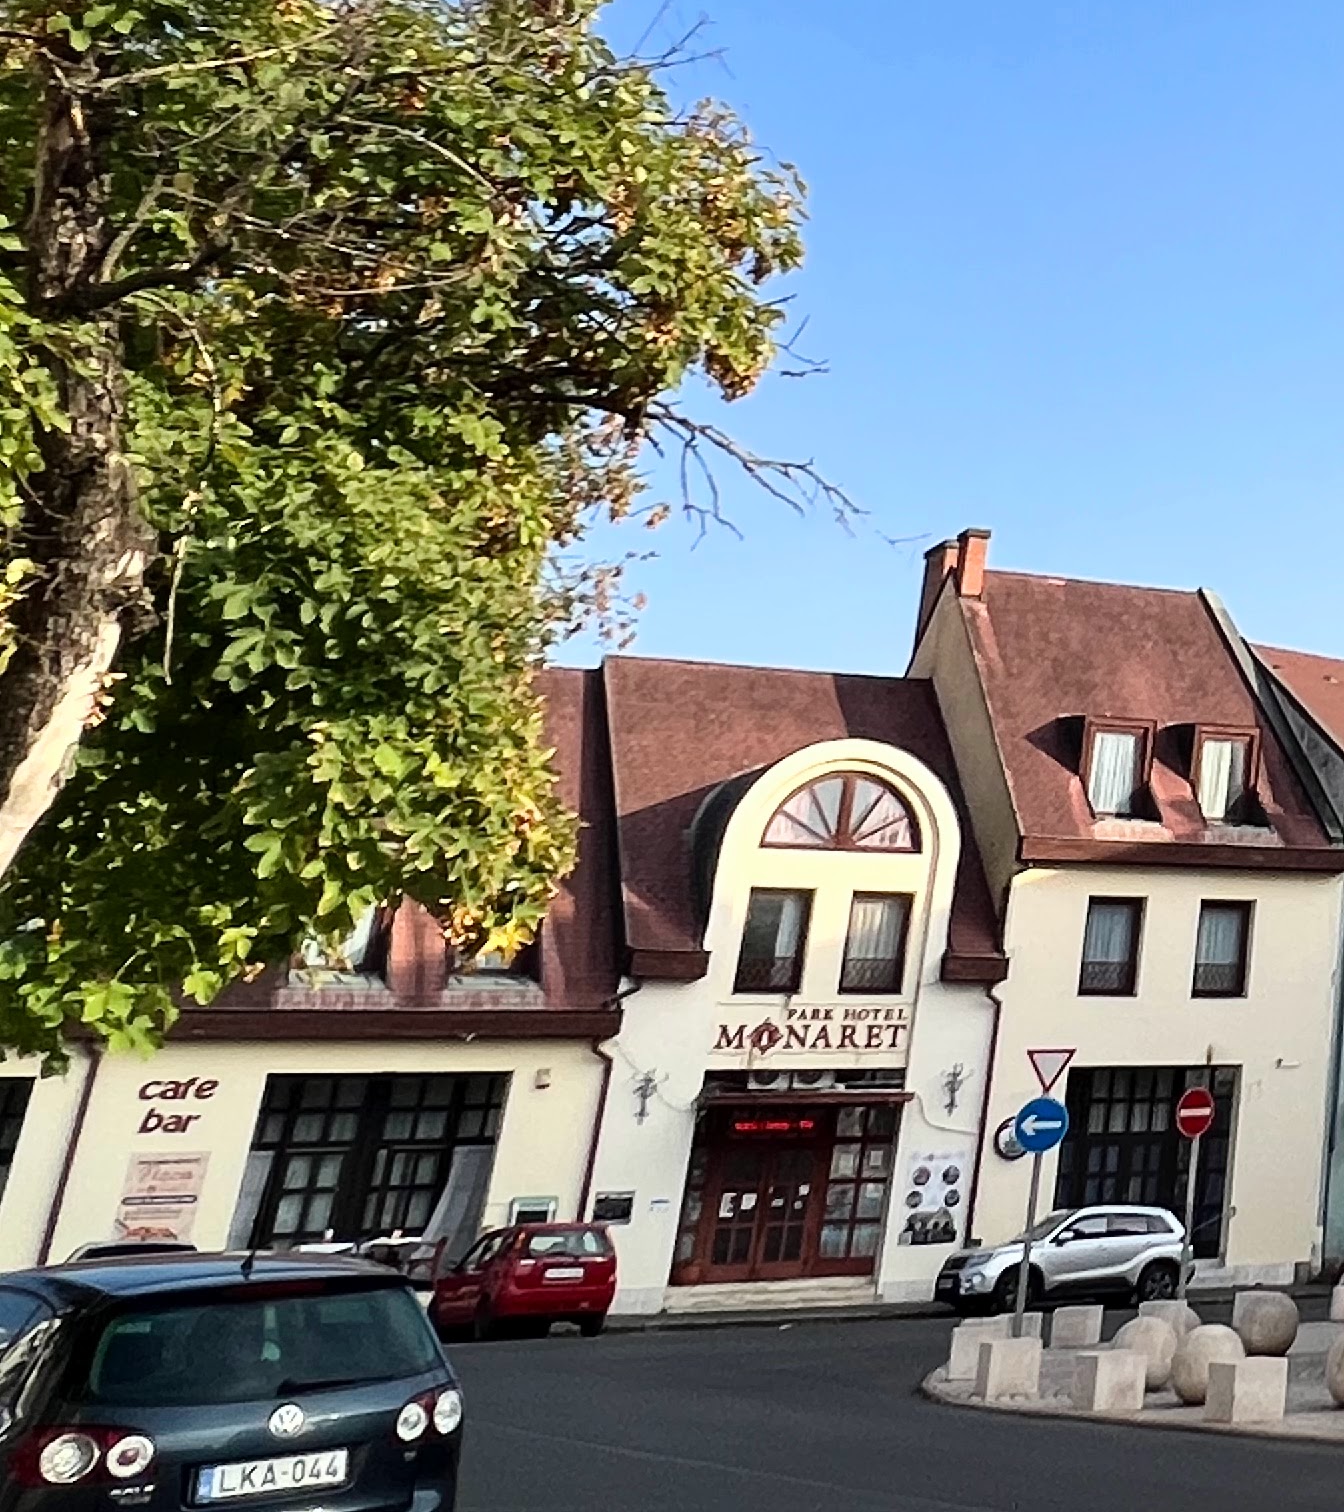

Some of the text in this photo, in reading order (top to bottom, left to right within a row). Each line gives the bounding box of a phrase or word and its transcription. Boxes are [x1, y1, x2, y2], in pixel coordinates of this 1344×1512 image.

[787, 1008, 909, 1021] PARK HOTEL
[138, 1076, 220, 1100] cafe
[137, 1107, 202, 1134] bar
[218, 1453, 340, 1494] LKA-044
